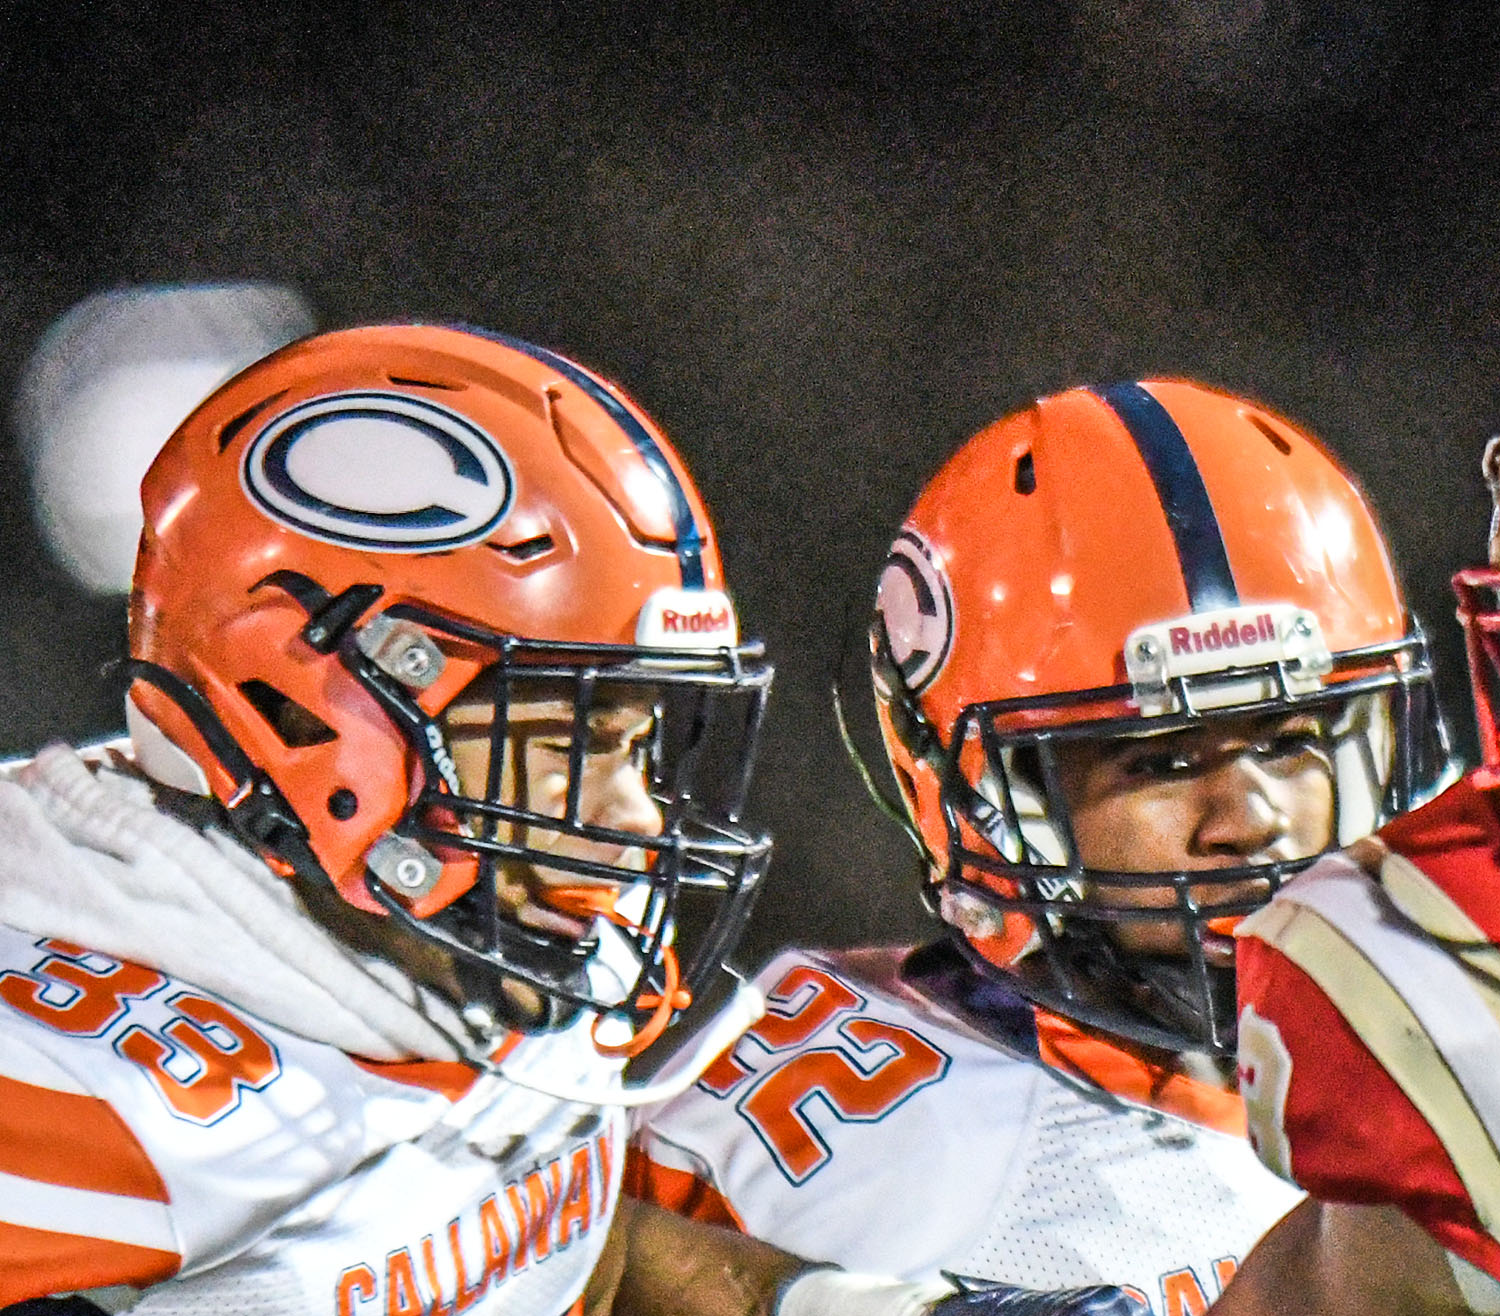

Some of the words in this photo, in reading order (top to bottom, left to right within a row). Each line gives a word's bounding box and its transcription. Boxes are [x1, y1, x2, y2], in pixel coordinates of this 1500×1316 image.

[1168, 613, 1277, 657] Riddell
[0, 937, 283, 1128] 33
[694, 965, 952, 1188] 22
